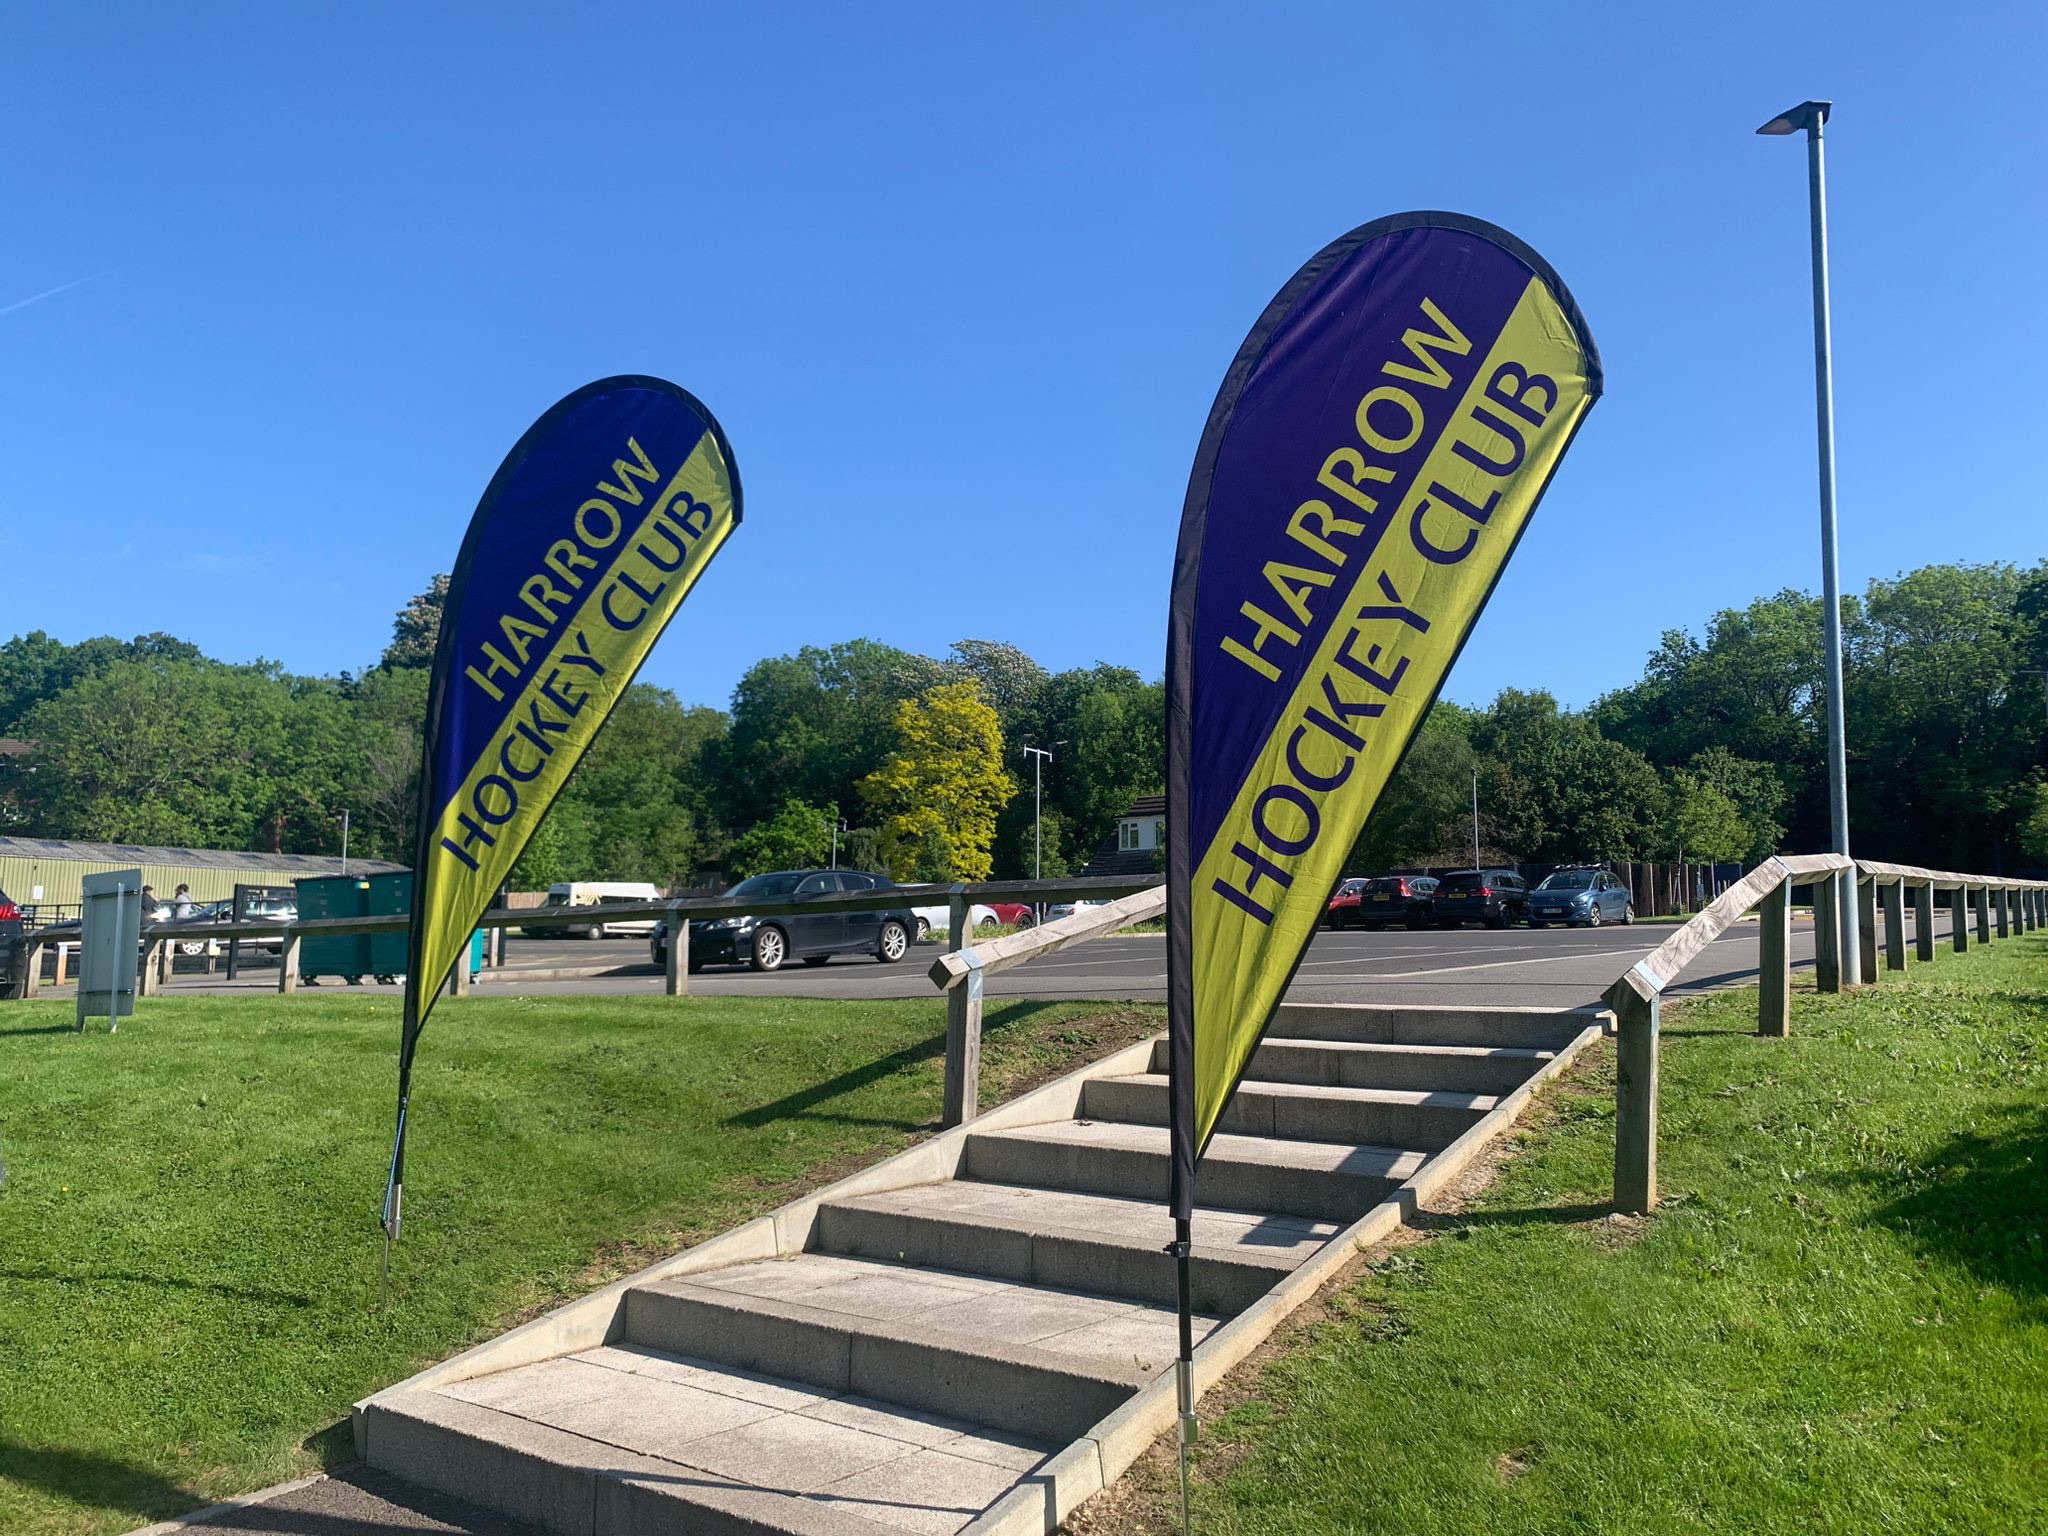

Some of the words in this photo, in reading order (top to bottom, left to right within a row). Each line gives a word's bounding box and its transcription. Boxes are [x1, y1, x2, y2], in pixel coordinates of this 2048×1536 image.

[441, 630, 606, 873] HOCKEY
[601, 489, 713, 632] CLUB
[465, 436, 661, 702] HARROW
[1211, 569, 1432, 925] HOCKEY
[1409, 359, 1559, 566] CLUB
[1219, 296, 1474, 682] HARROW
